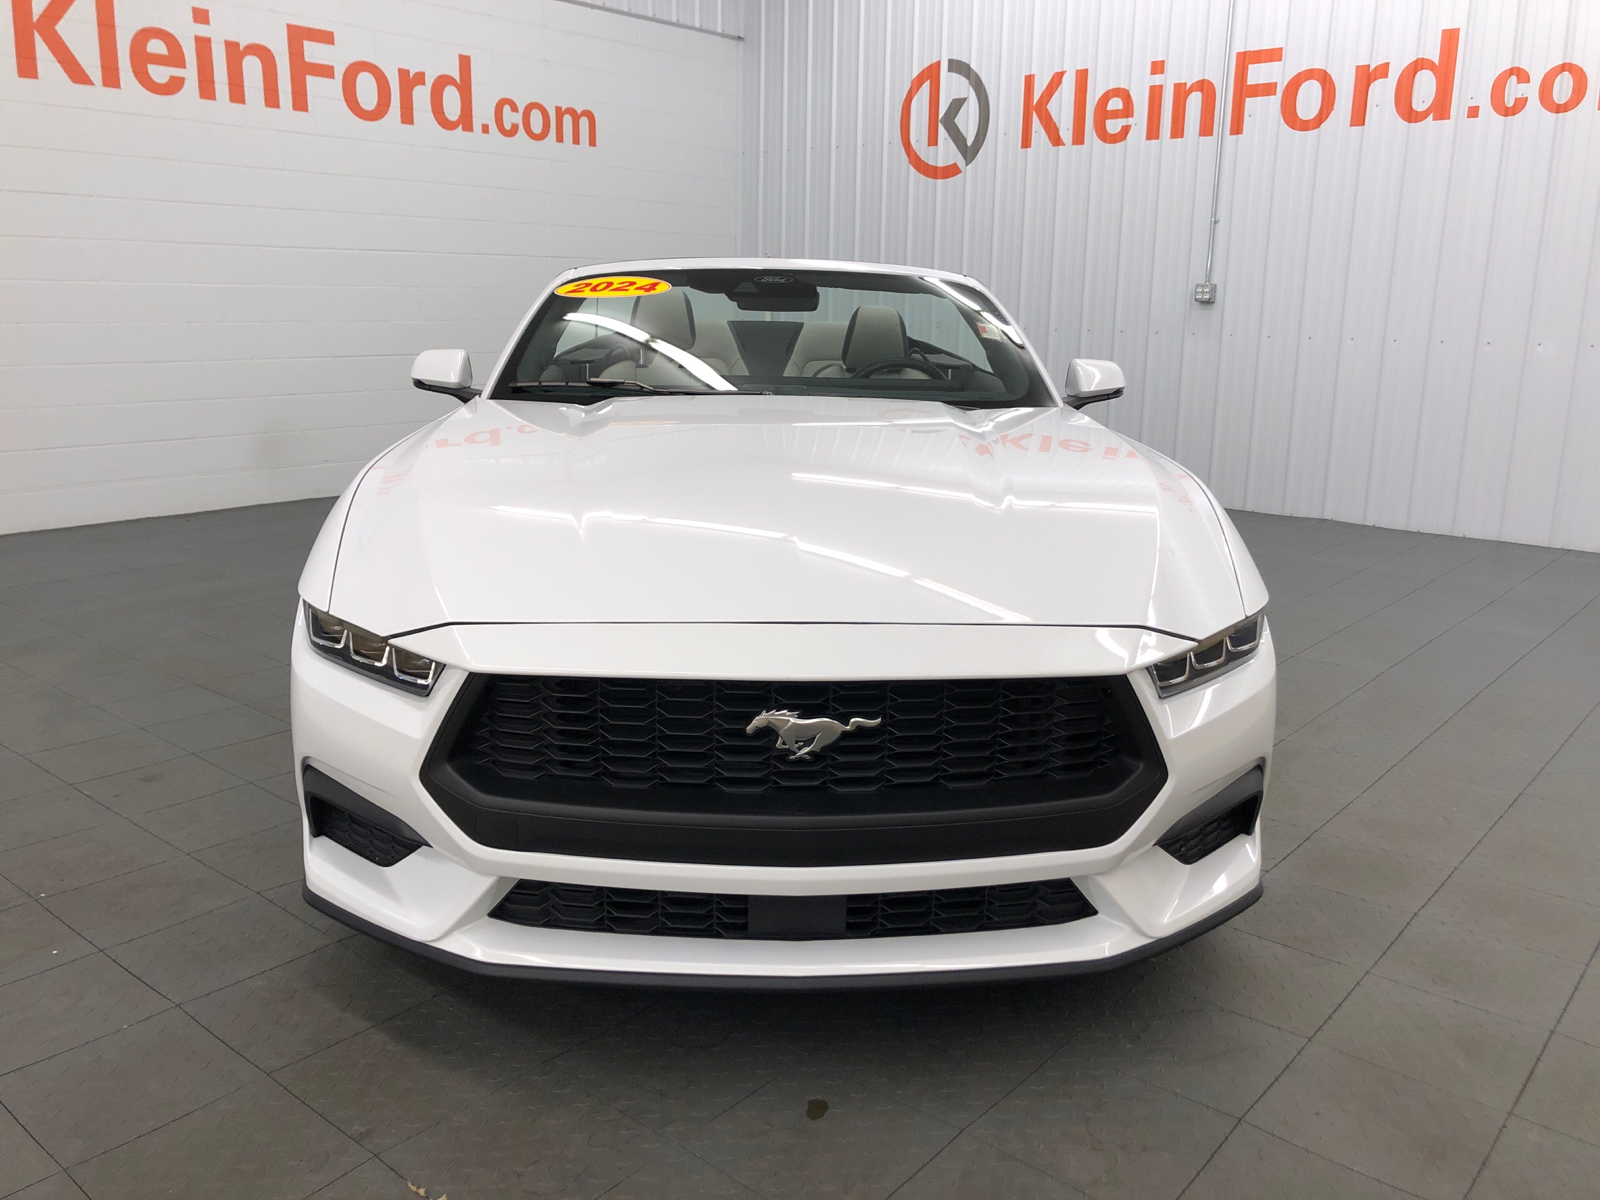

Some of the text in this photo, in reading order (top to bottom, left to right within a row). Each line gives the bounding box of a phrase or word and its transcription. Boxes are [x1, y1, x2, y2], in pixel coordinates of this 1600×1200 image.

[11, 0, 598, 148] KleinFord.com
[1020, 28, 1600, 149] KleinFord.co
[564, 280, 661, 293] 2024
